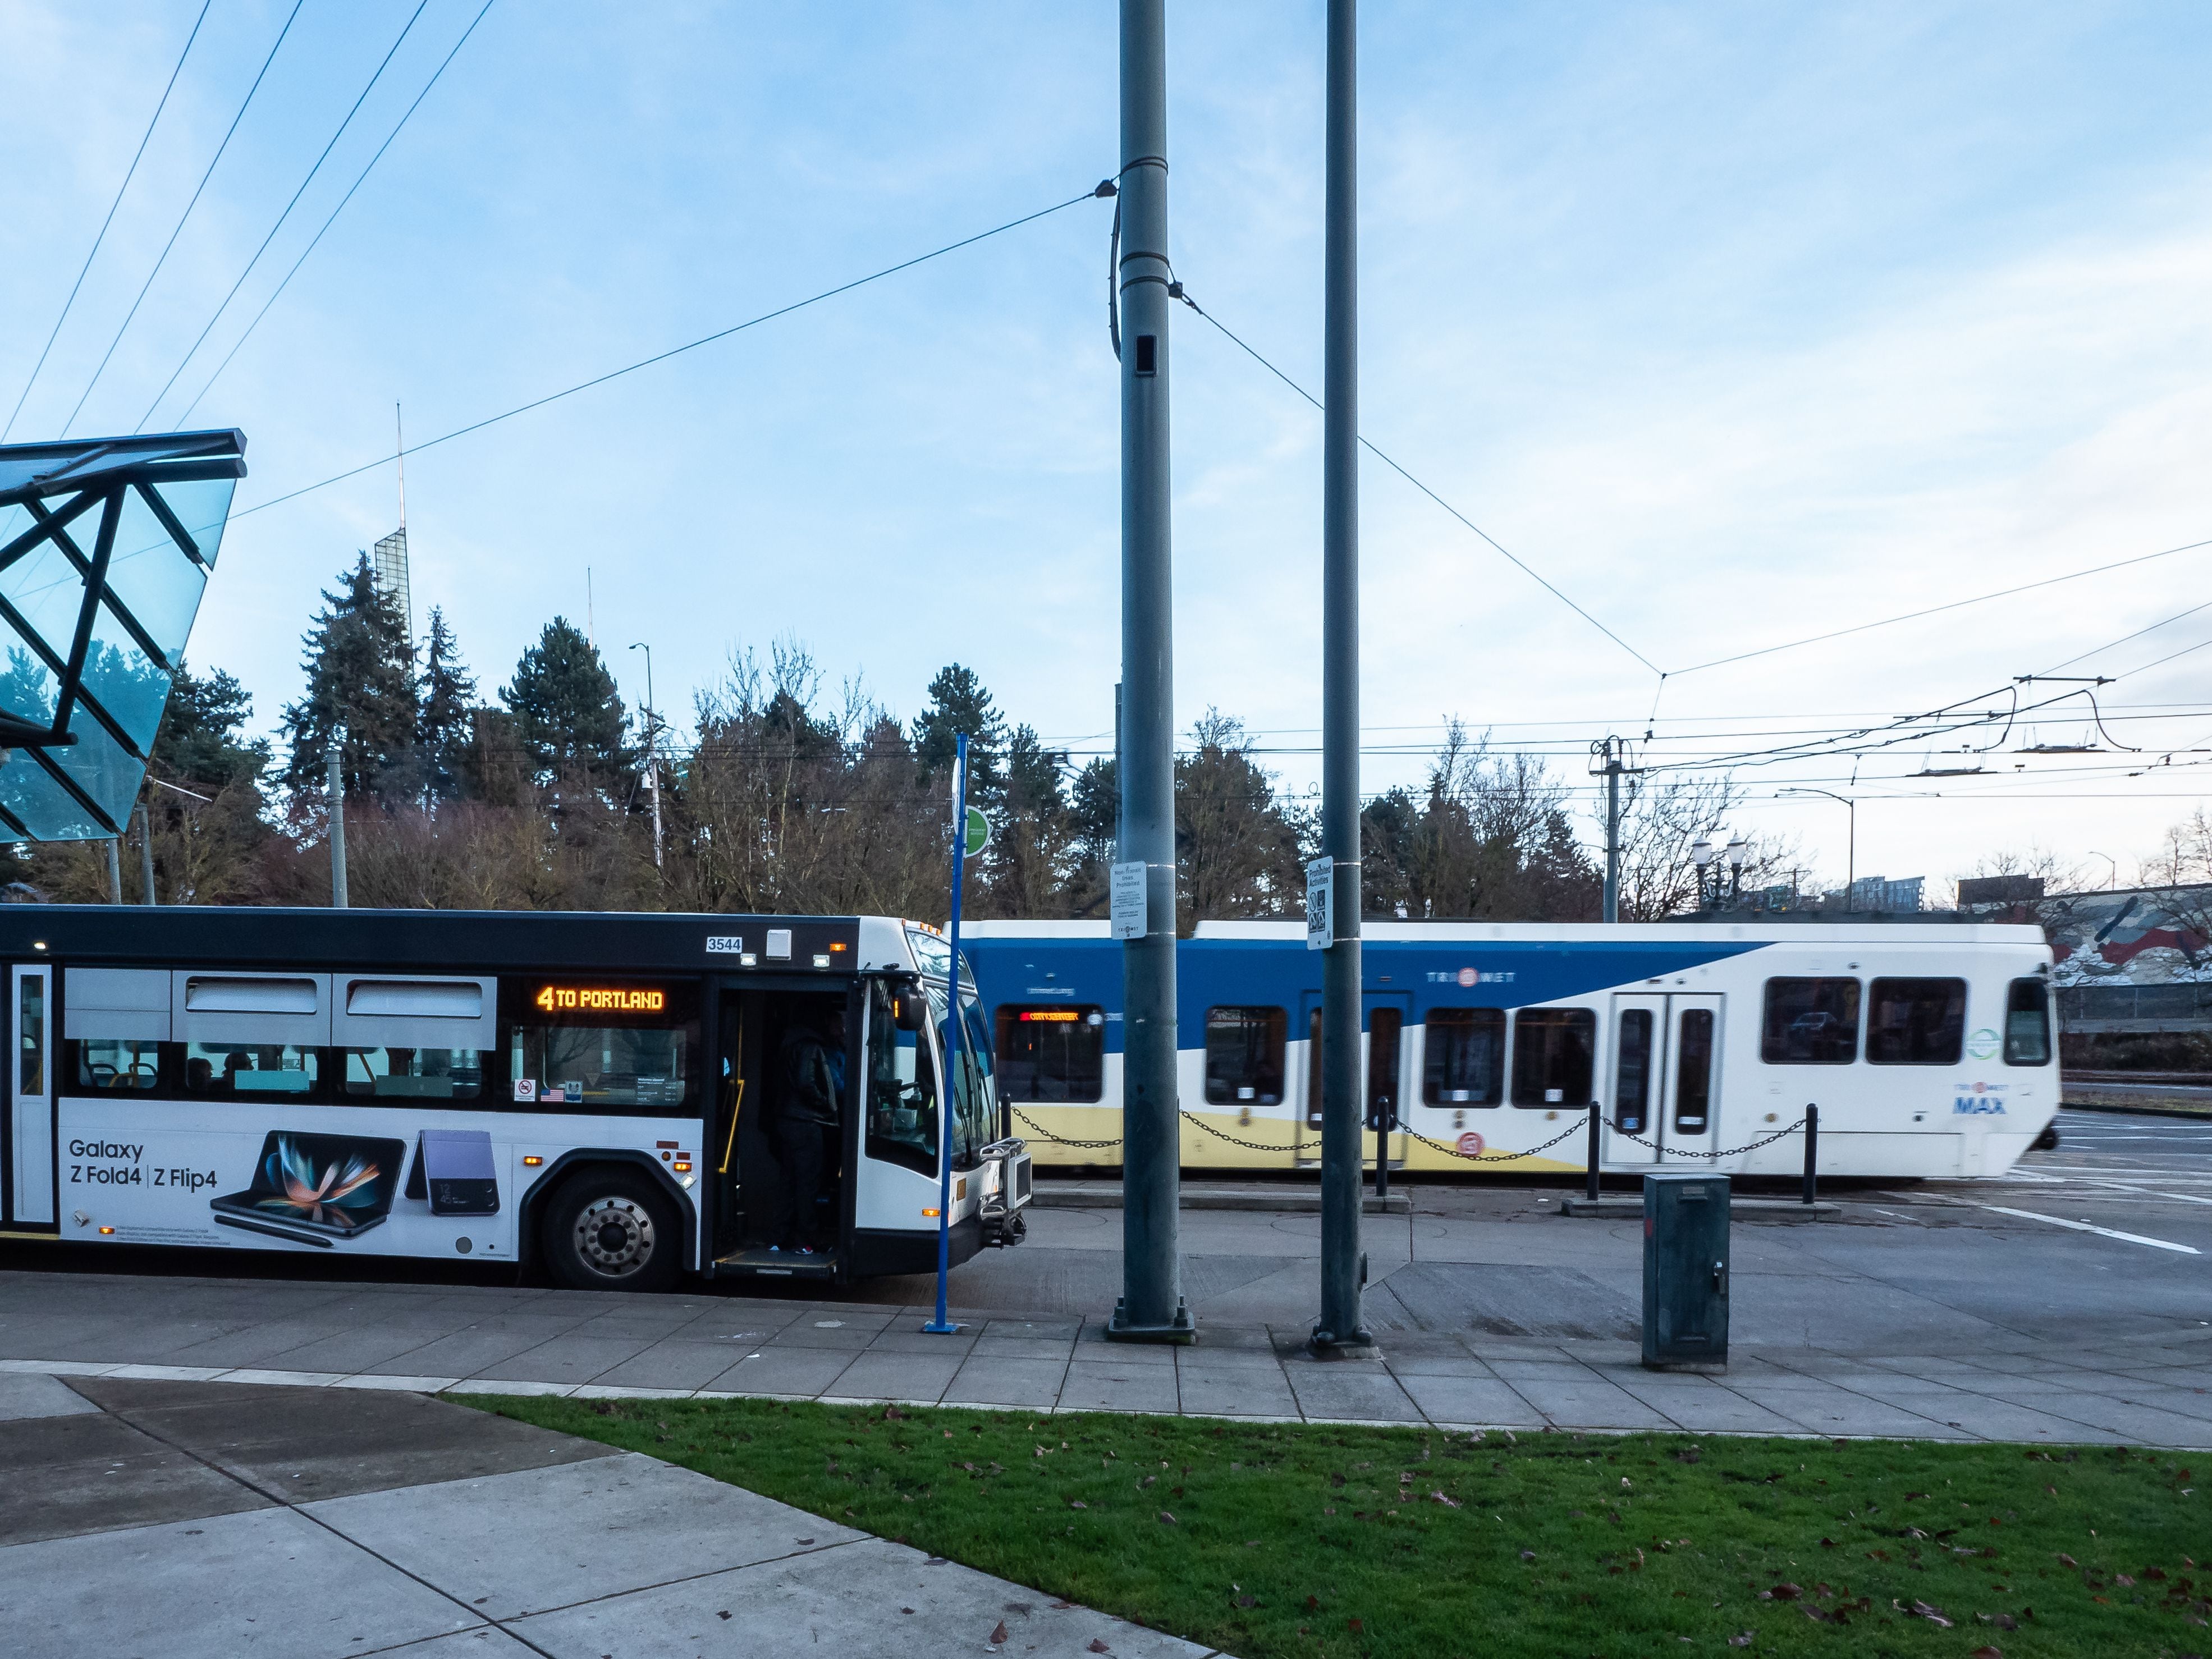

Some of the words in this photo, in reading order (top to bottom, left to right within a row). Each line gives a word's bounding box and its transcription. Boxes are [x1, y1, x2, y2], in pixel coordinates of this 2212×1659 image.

[708, 938, 740, 950] 3544
[538, 987, 554, 1011] 4
[556, 990, 576, 1007] TO
[580, 990, 663, 1009] PORTLAND
[1953, 1097, 2008, 1114] MAX
[70, 1139, 144, 1163] Galaxy
[71, 1165, 81, 1183] Z
[87, 1166, 141, 1185] Fold4
[154, 1168, 165, 1186] Z
[171, 1168, 217, 1193] Flip4
